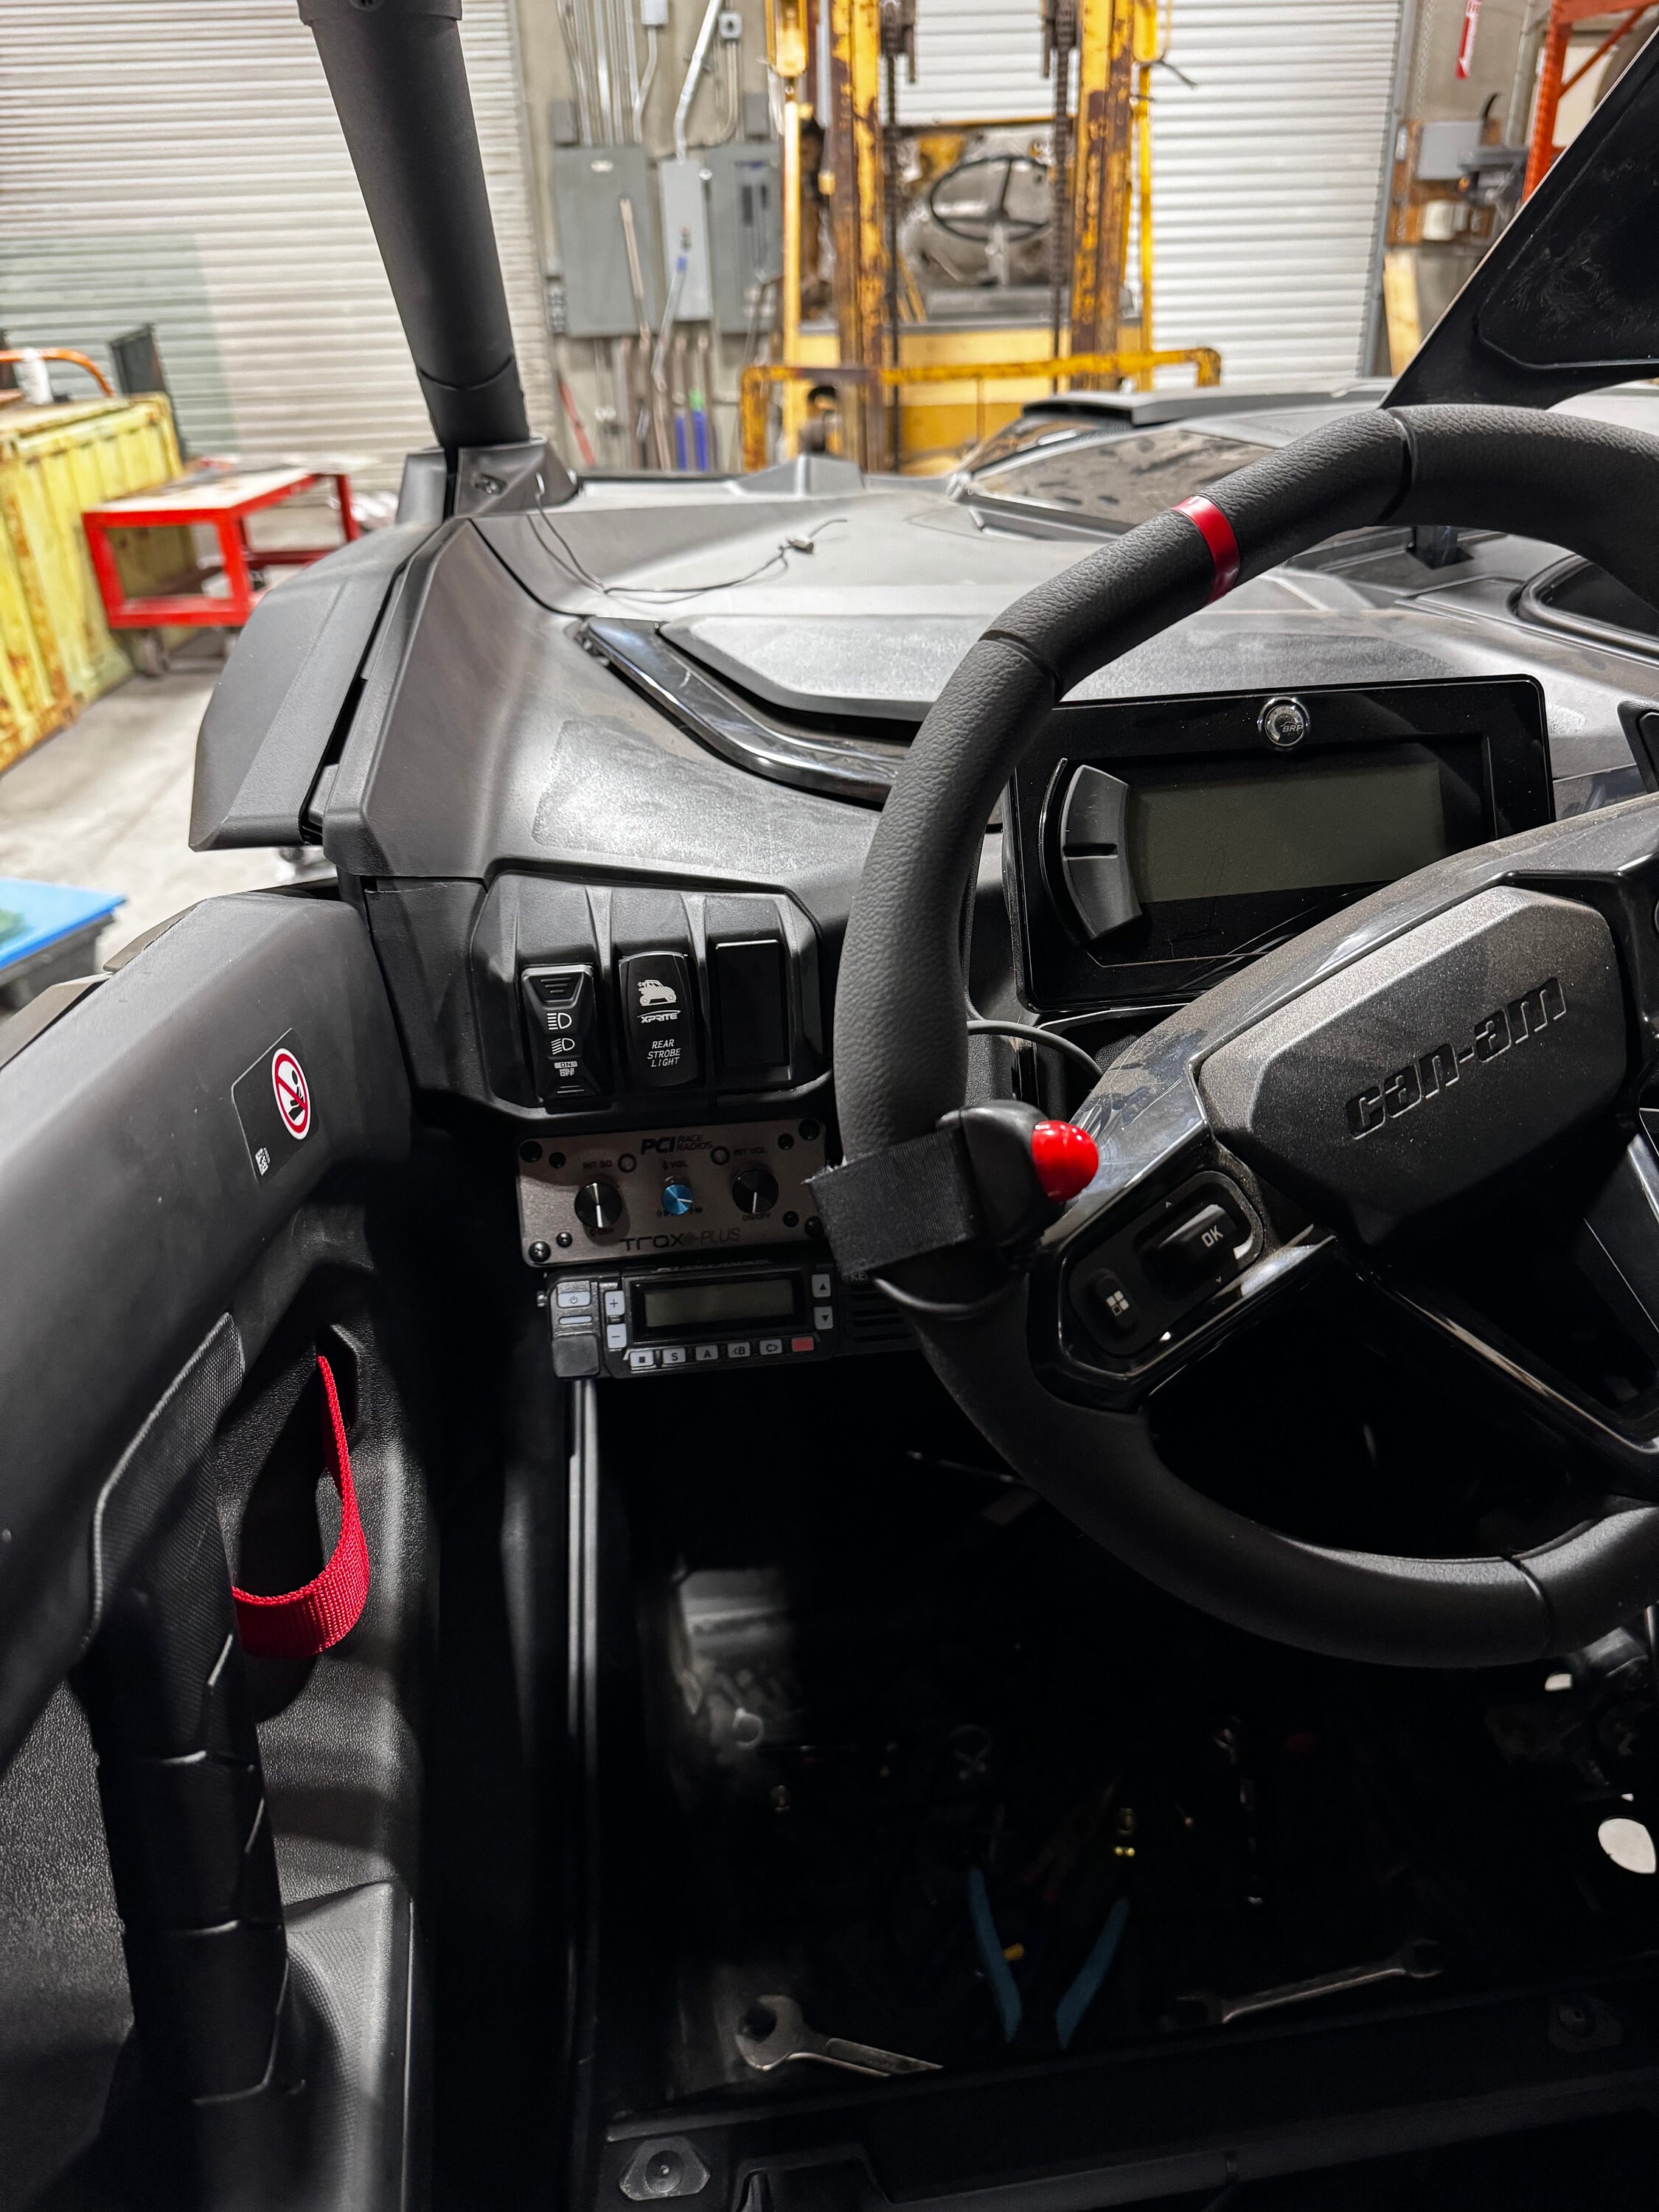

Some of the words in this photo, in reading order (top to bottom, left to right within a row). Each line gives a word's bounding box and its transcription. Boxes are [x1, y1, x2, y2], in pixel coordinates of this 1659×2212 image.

[1282, 724, 1304, 733] BRP
[640, 1012, 678, 1024] XPRITE
[652, 1039, 675, 1049] REAR
[647, 1048, 682, 1060] STROBE
[1346, 977, 1566, 1140] can-am
[650, 1057, 681, 1068] LIGHT
[677, 1134, 704, 1144] RACE
[641, 1136, 675, 1155] PCI
[677, 1141, 713, 1151] RADIOS
[700, 1228, 740, 1245] PLUS
[1201, 1225, 1224, 1248] OK
[672, 1352, 678, 1361] S
[703, 1350, 711, 1358] A
